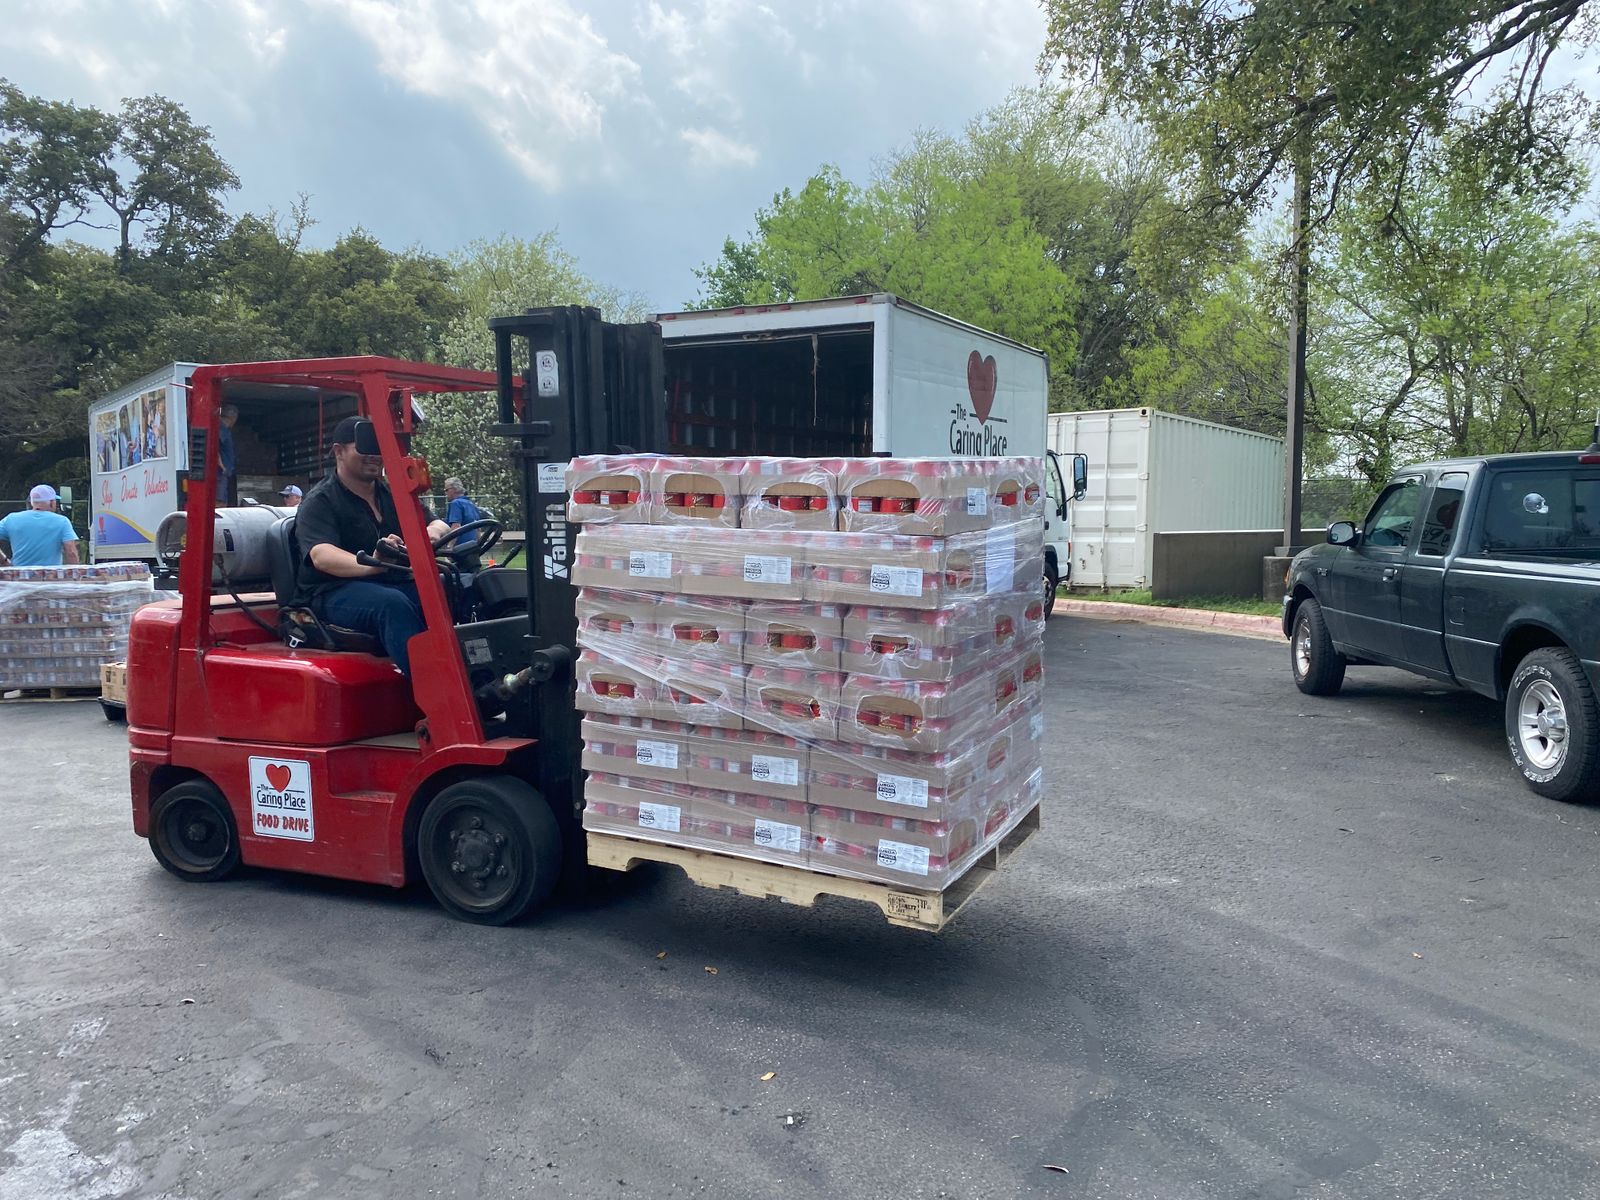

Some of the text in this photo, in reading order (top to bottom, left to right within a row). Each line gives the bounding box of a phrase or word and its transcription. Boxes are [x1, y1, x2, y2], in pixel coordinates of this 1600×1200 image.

[956, 403, 967, 421] The
[950, 420, 1007, 457] Caring Place
[1514, 665, 1552, 688] COOPER
[260, 783, 269, 791] The
[256, 790, 306, 809] Caring Place
[256, 812, 309, 833] FOOD DRIVE
